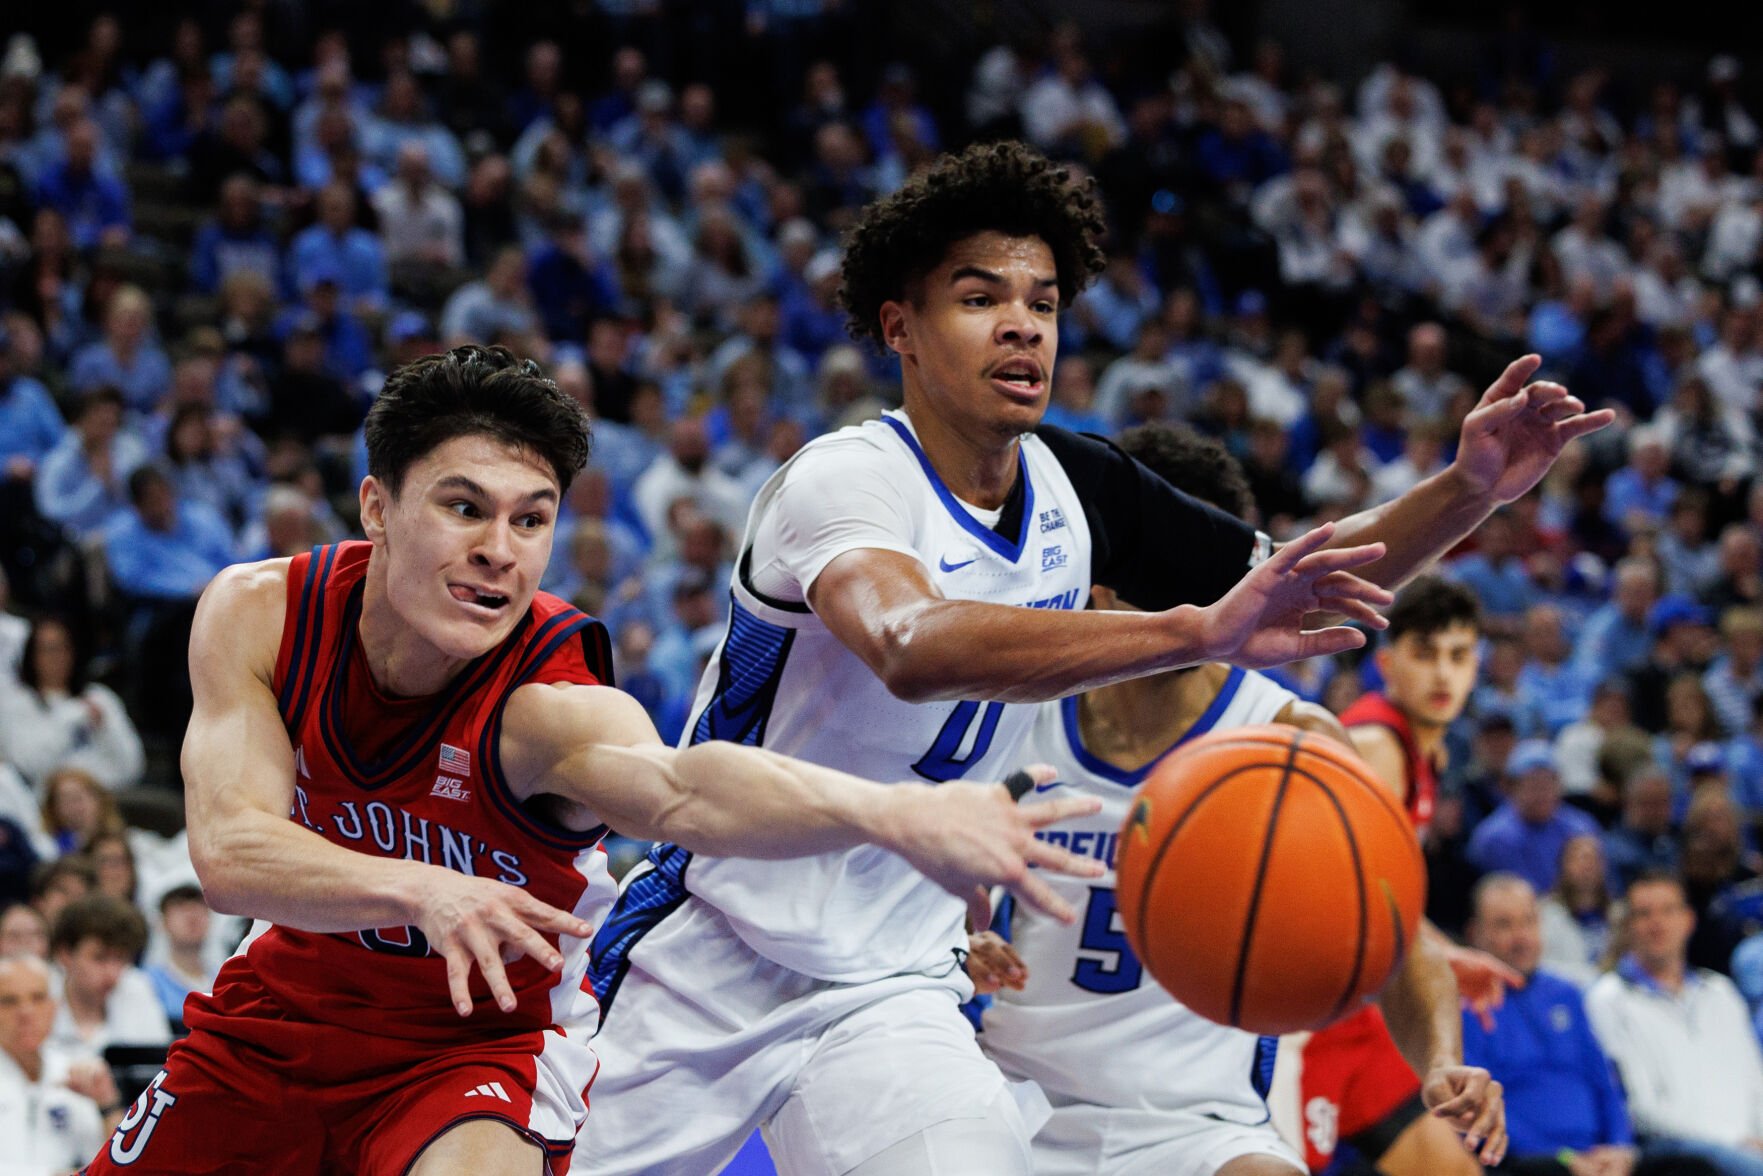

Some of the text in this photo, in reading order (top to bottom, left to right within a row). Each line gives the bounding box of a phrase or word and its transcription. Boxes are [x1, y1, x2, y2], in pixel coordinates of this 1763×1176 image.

[1042, 546, 1061, 558] BIG
[1042, 555, 1067, 567] EAST
[436, 775, 463, 789] BIG
[432, 784, 471, 799] EAST
[333, 801, 528, 887] JOHN'S
[1070, 885, 1144, 994] 5
